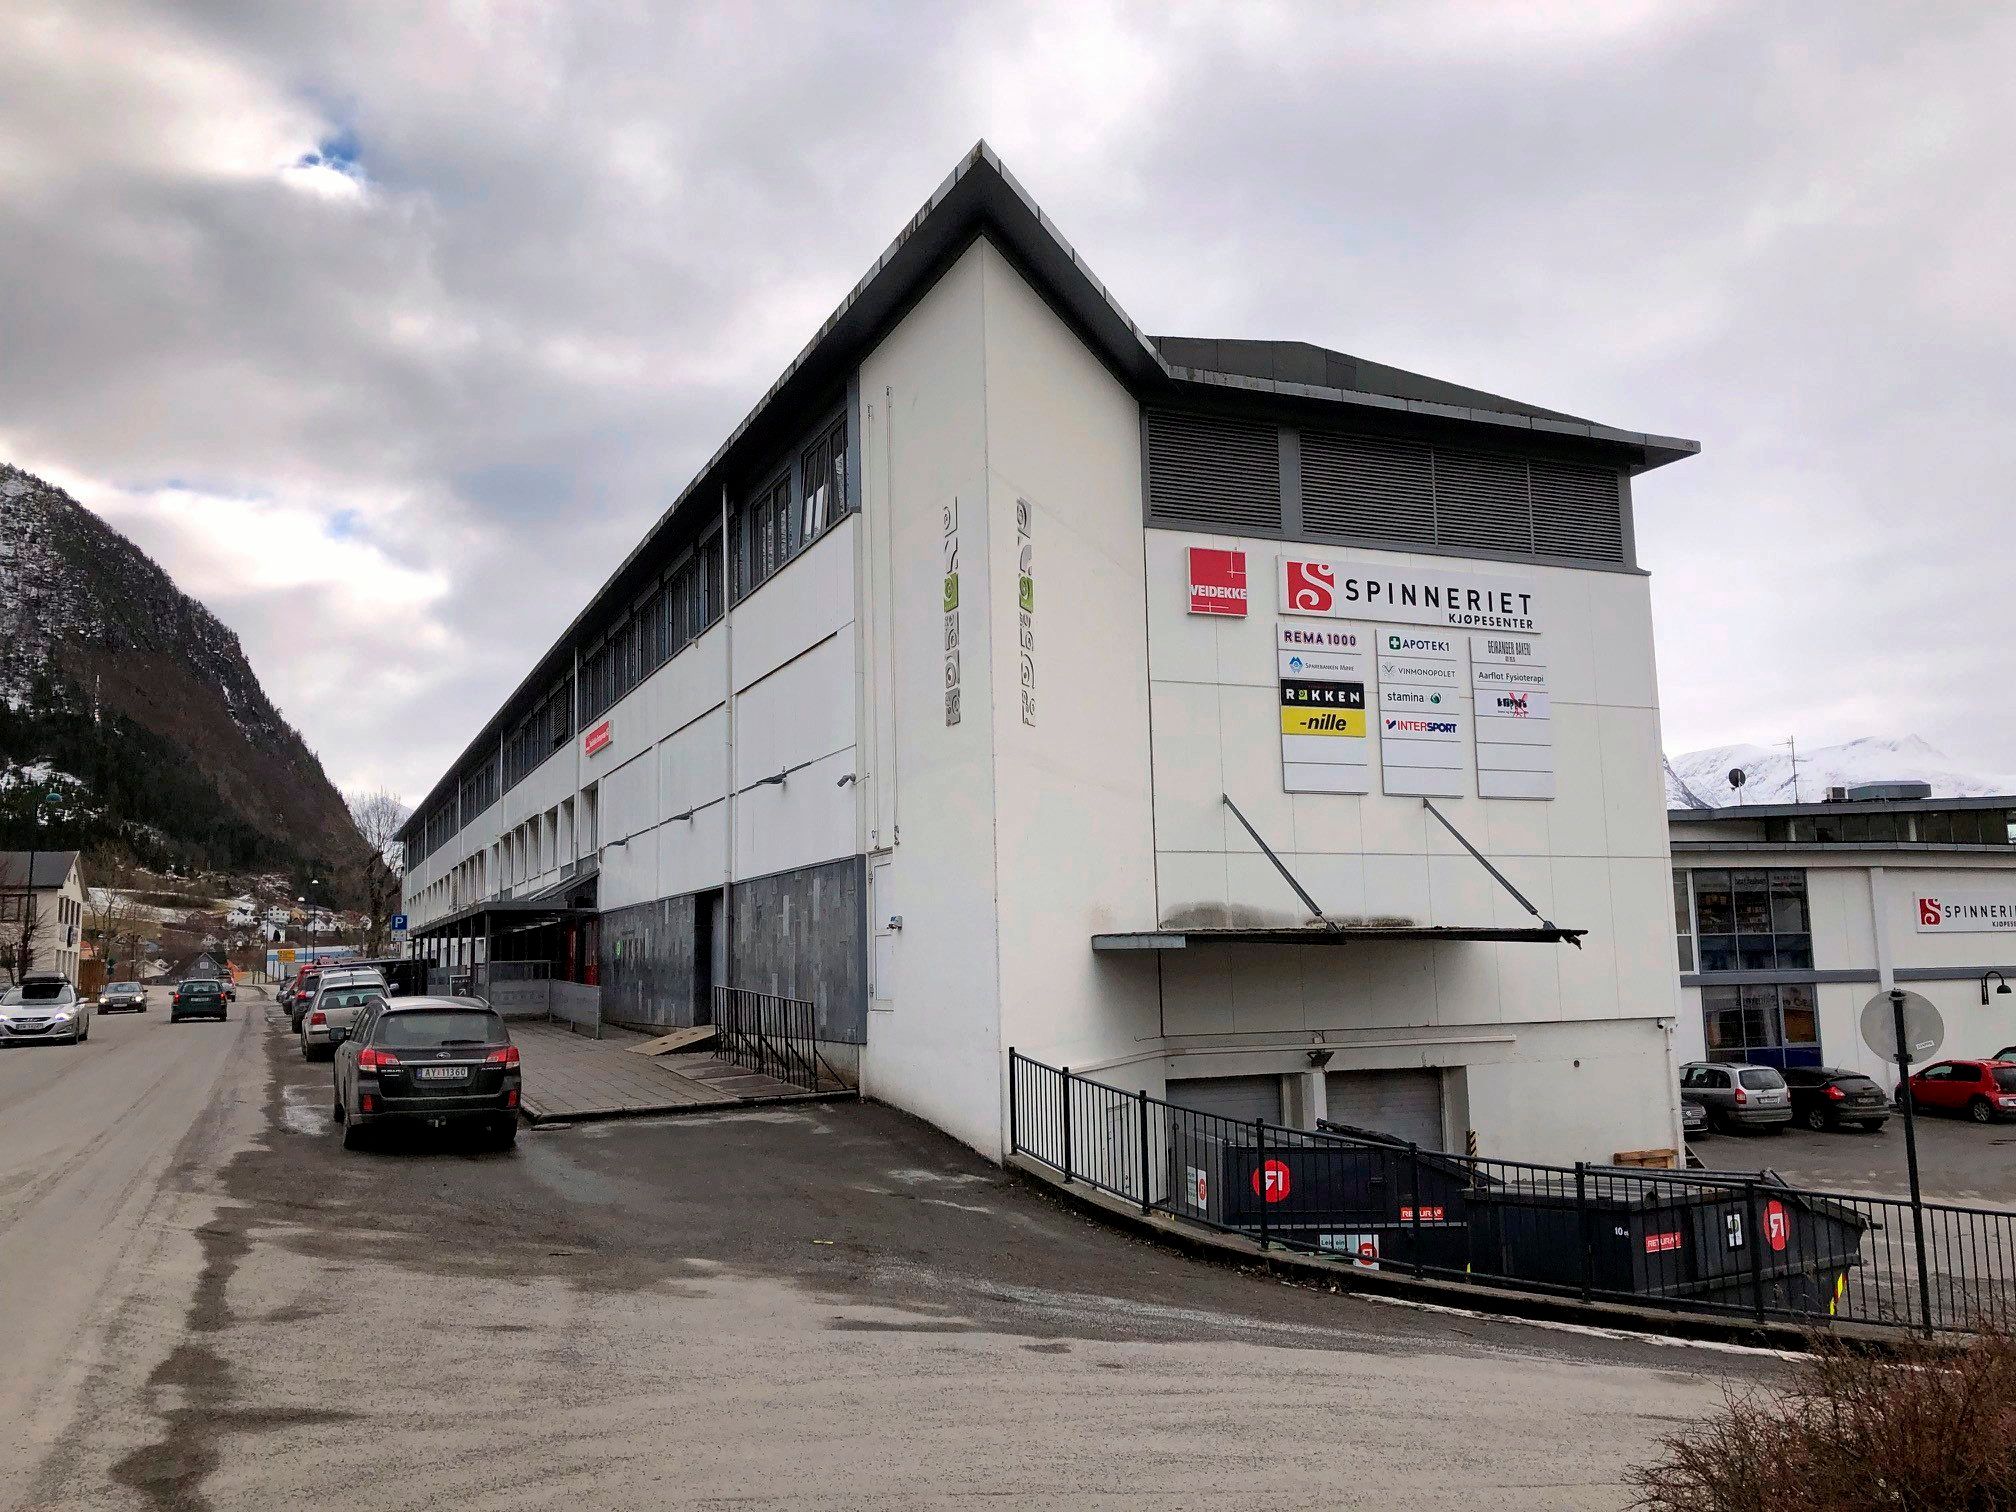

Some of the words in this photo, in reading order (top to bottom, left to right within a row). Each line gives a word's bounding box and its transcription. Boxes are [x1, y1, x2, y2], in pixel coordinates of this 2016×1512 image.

[1189, 584, 1247, 600] VEIDEKKE
[1345, 579, 1531, 615] SPINNERIET
[1449, 613, 1533, 629] KJØPESENTER
[1284, 630, 1324, 643] REMA
[1327, 633, 1356, 646] 1000
[1398, 667, 1456, 678] VINMONOPOLET
[1387, 692, 1425, 702] stamina
[1397, 720, 1457, 733] INTERSPORT
[394, 916, 404, 928] P
